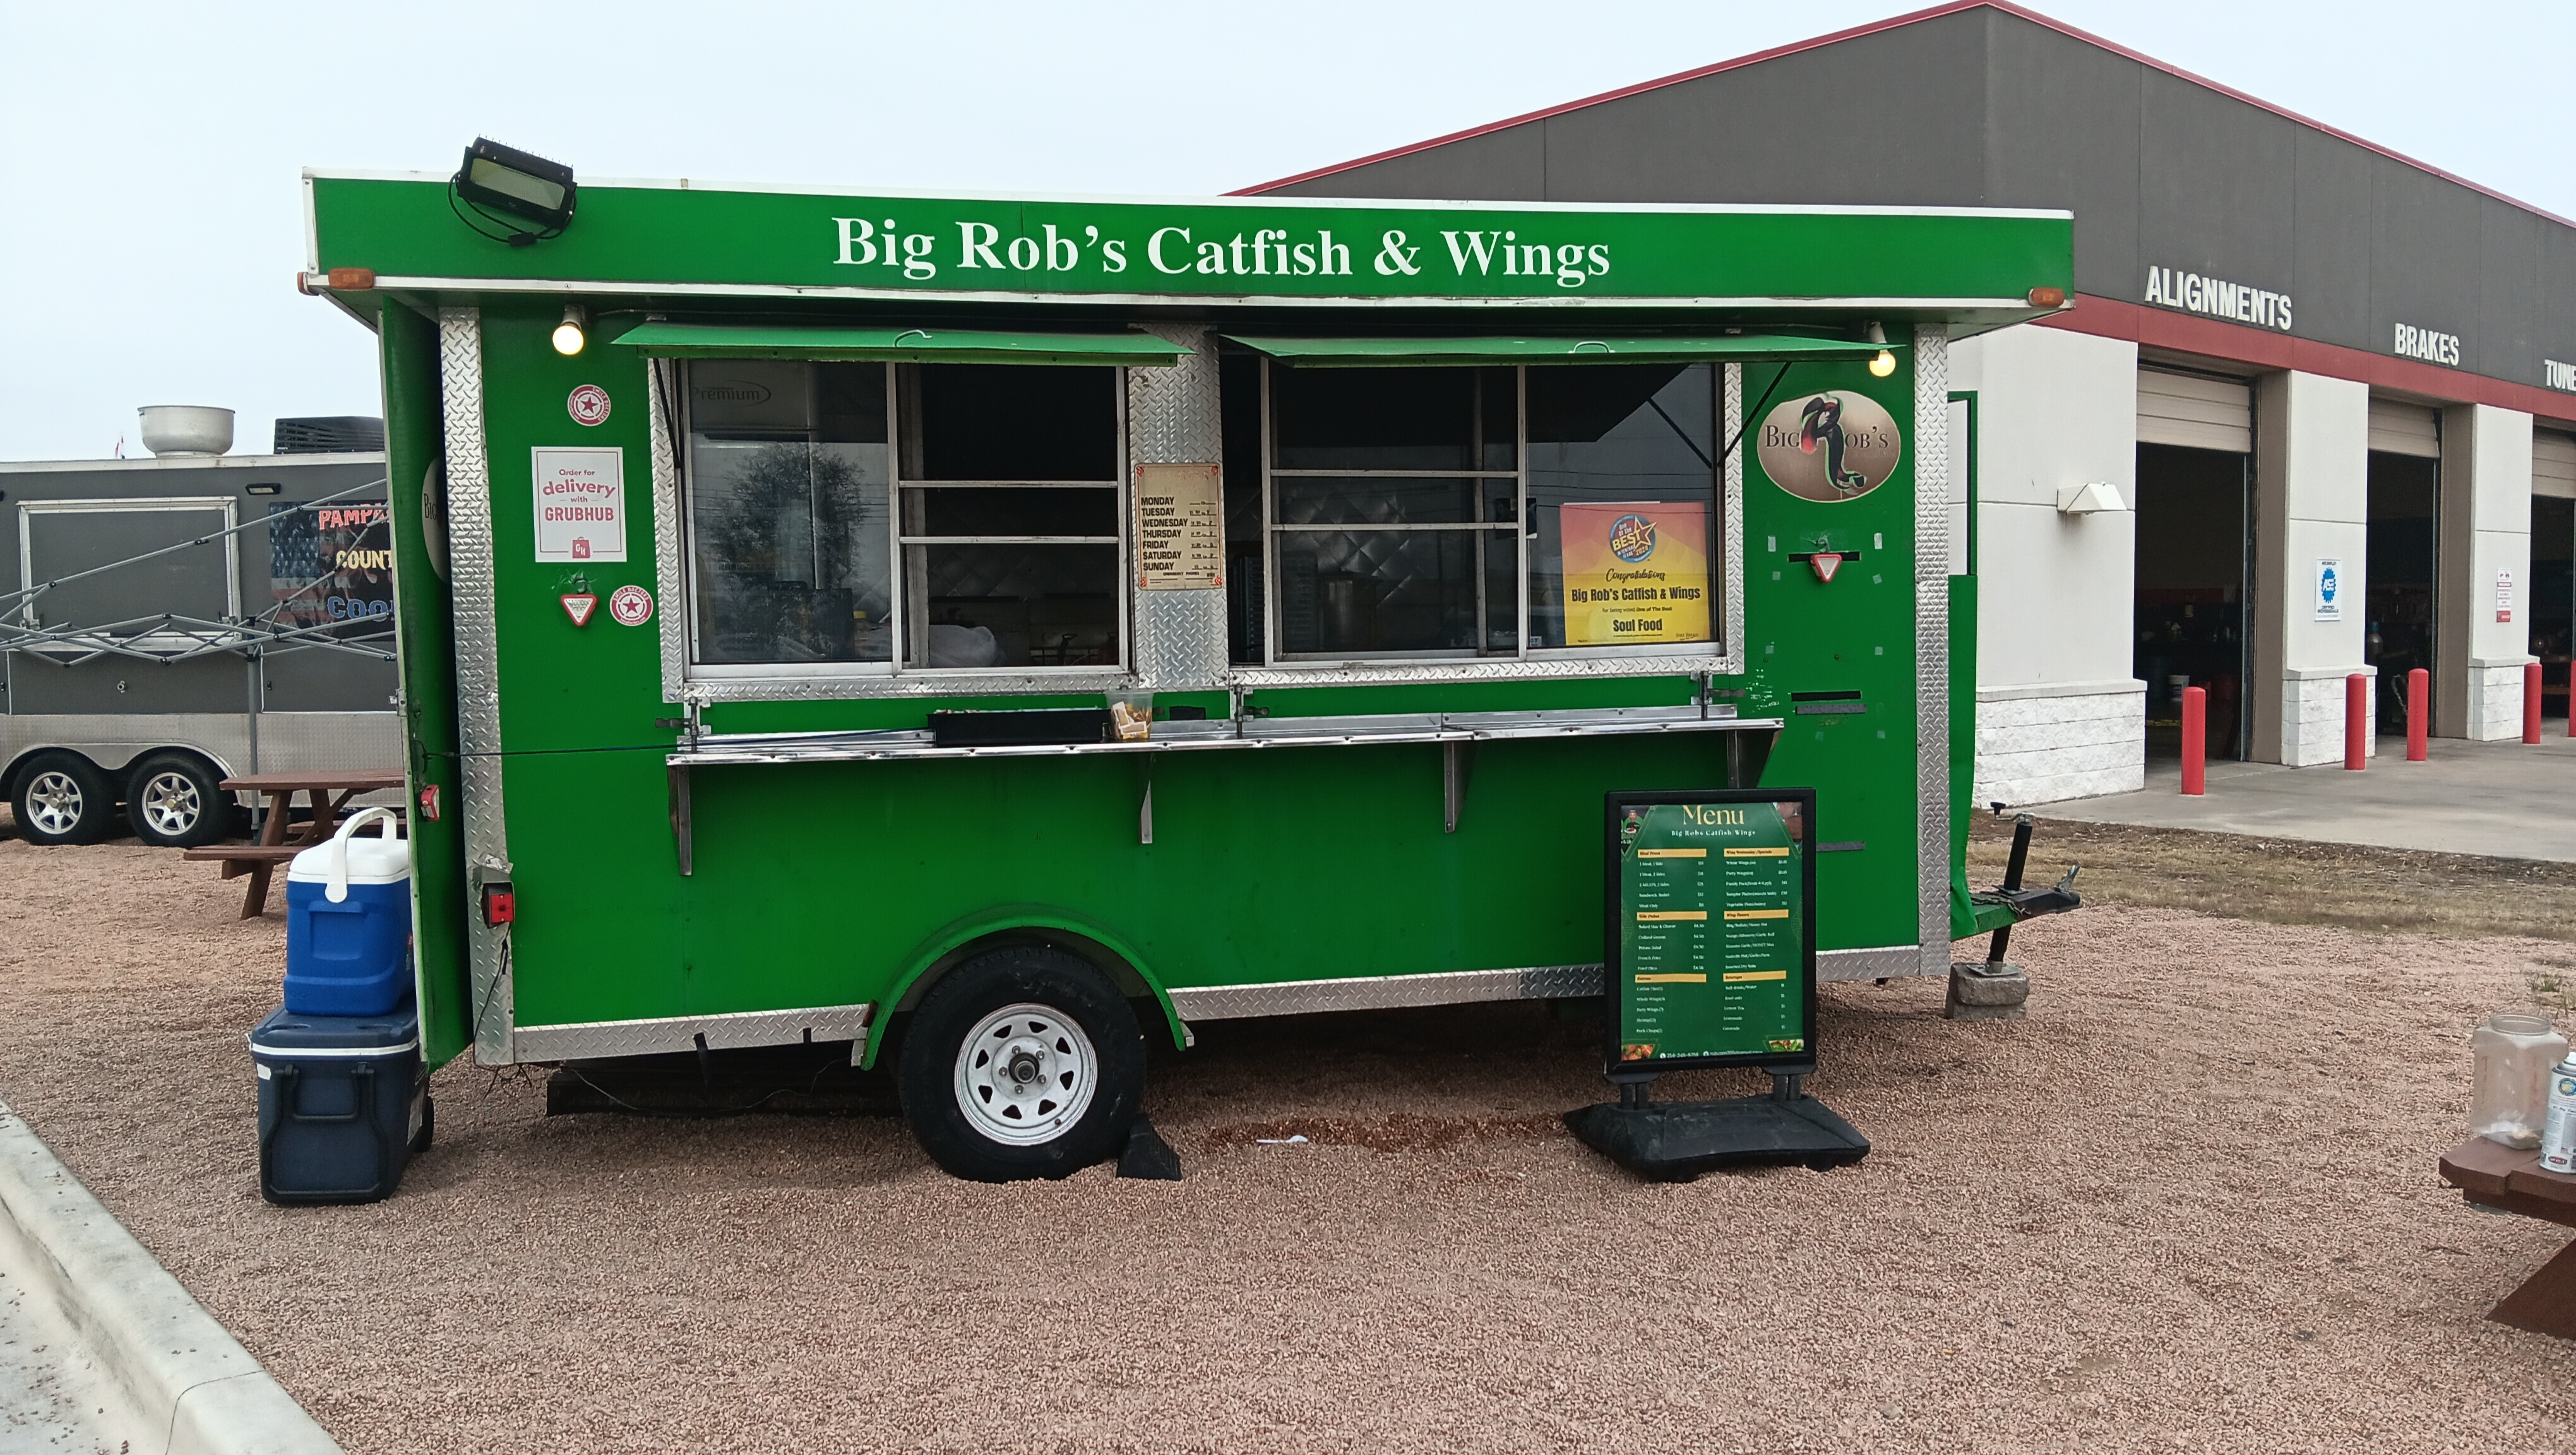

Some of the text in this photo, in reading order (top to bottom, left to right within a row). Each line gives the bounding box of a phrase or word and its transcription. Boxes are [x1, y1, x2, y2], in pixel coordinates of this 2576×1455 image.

[831, 217, 1610, 288] Big Rob's Catfish & Wings
[2144, 265, 2292, 330] ALIGNMENTS
[2394, 323, 2460, 366] BRAKES
[1765, 425, 1800, 449] BIG
[542, 479, 616, 499] delivery
[1141, 497, 1175, 506] MONDAY
[544, 507, 614, 522] GRUBHUB
[1142, 508, 1175, 516] TUESDAY
[1142, 518, 1188, 527] WEDNESDAY
[1142, 530, 1182, 538] THURSDAY
[1612, 528, 1640, 552] BEST
[1142, 540, 1169, 549] FRIDAY
[1143, 551, 1182, 560] SATURDAY
[1143, 562, 1174, 571] SUNDAY
[1606, 568, 1666, 584] Congratulations
[1571, 586, 1701, 603] Big Rob's Catfish & Wings
[327, 596, 394, 622] COO
[1613, 618, 1662, 632] Soul Food
[1682, 805, 1744, 825] Menu
